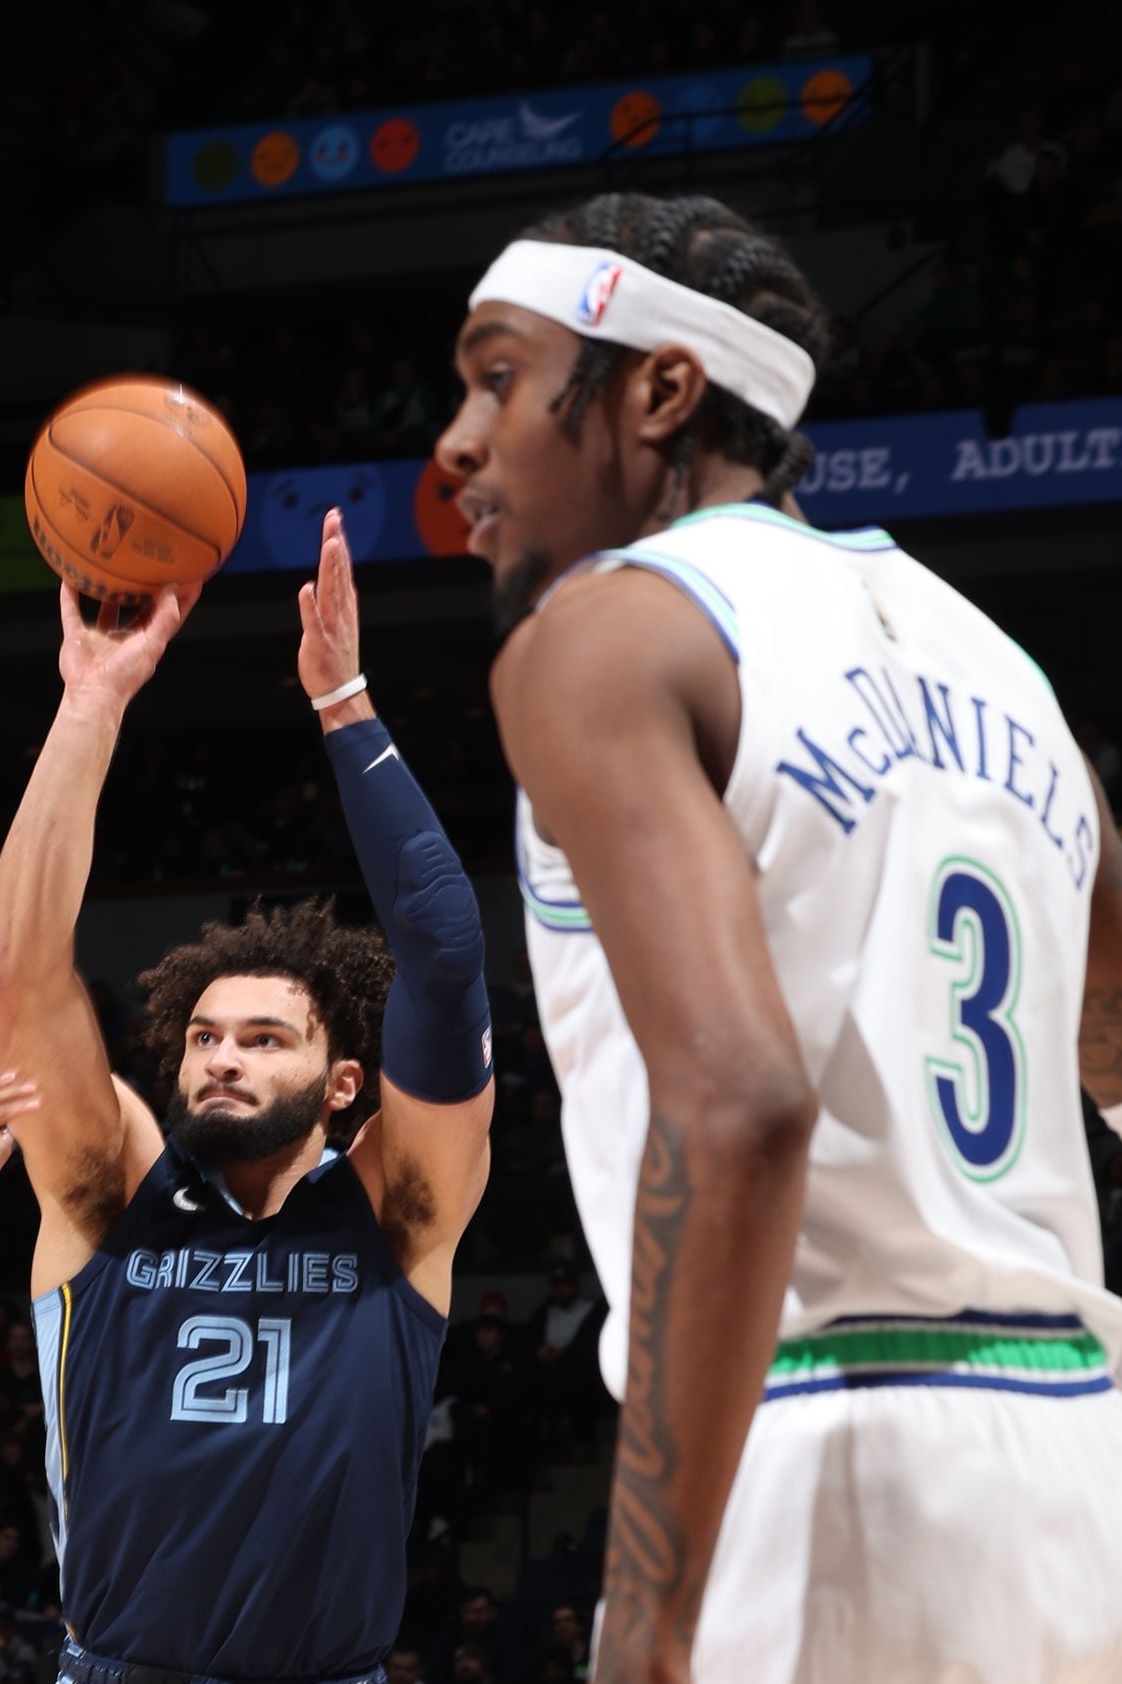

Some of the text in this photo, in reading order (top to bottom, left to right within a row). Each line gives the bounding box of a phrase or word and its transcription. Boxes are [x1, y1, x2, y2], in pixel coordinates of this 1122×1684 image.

[925, 855, 1028, 1184] 3
[126, 1248, 360, 1294] GRIZZLIES
[170, 1314, 293, 1425] 21
